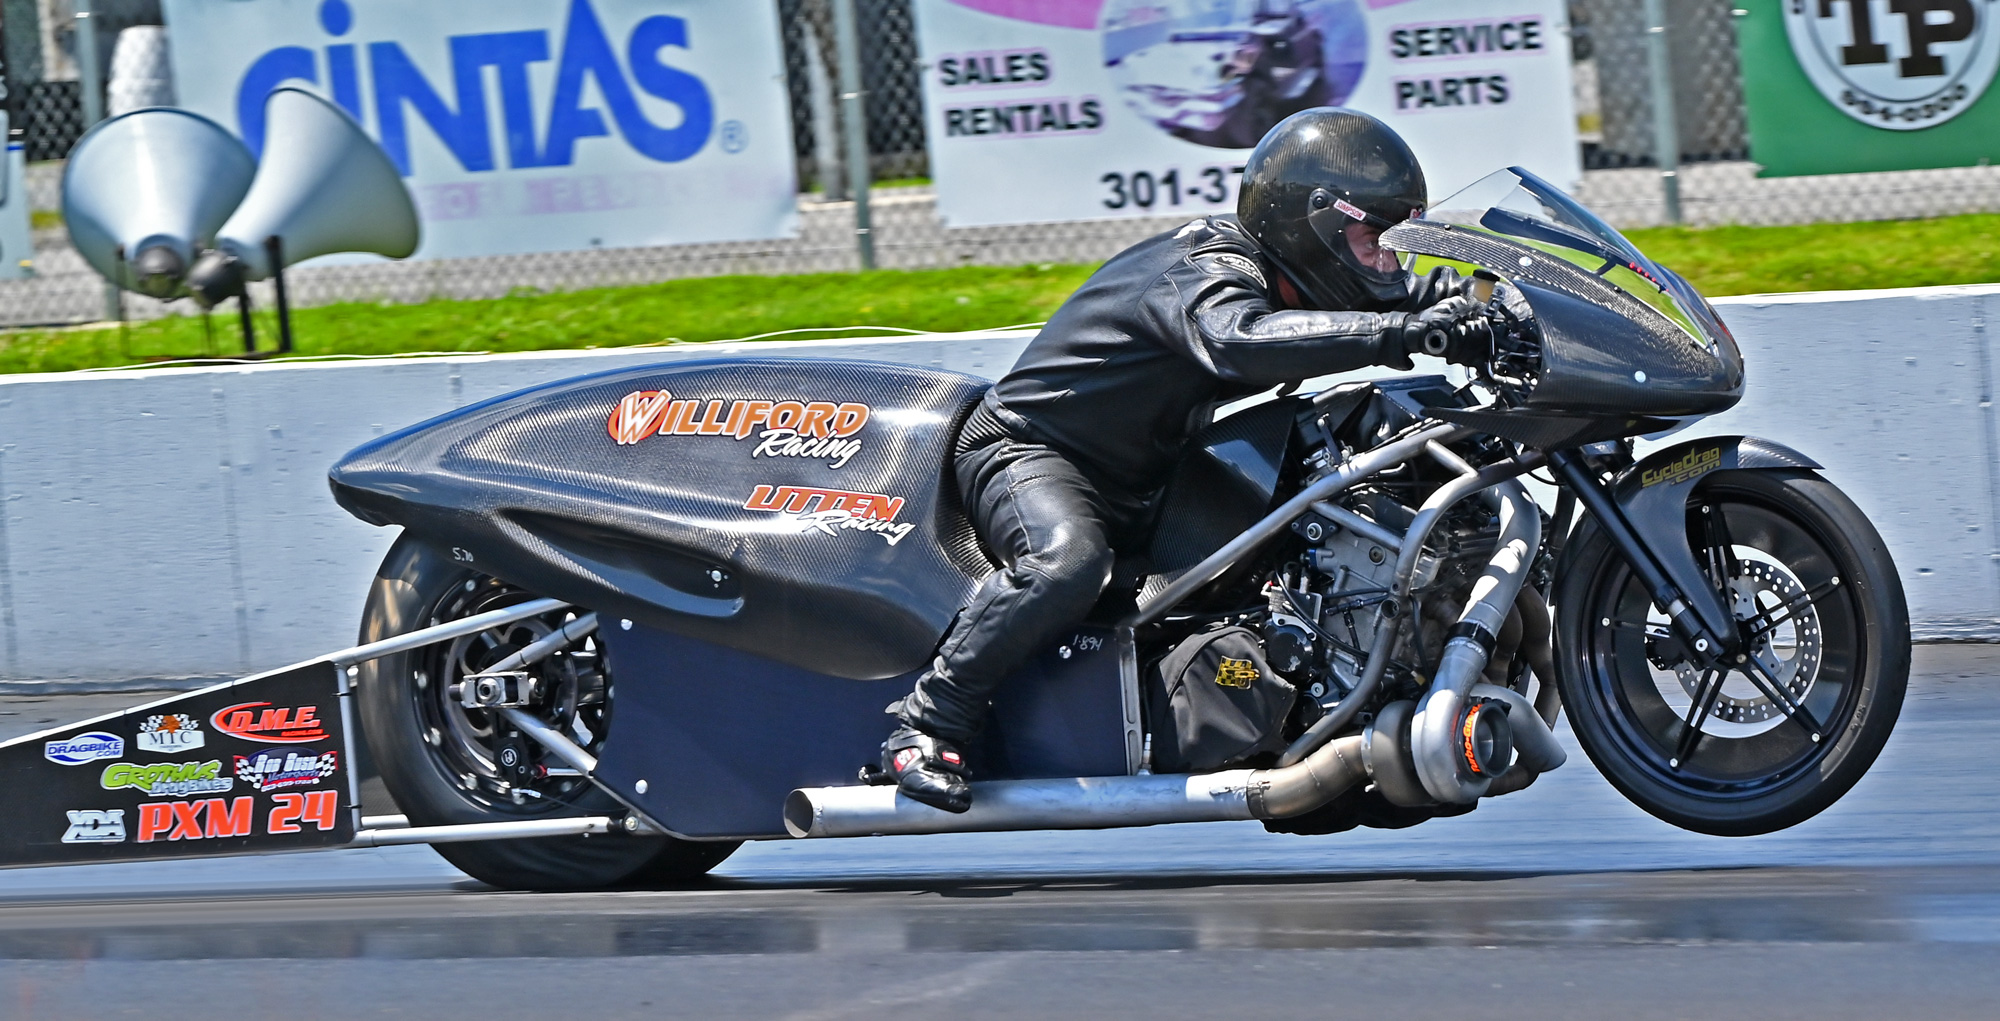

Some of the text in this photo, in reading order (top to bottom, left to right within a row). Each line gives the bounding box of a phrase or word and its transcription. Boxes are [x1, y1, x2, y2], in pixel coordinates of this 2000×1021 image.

[1390, 21, 1543, 58] SERVICE
[1817, 0, 1976, 78] TP
[939, 53, 1050, 86] SALES
[1396, 75, 1509, 109] PARTS
[945, 101, 1103, 137] RENTALS
[1335, 201, 1364, 219] SIMPSON
[607, 389, 870, 445] WILLIFORD
[752, 429, 862, 469] Racing
[743, 485, 905, 524] UTTEN
[797, 509, 916, 546] Racing
[149, 730, 192, 745] MTC
[226, 706, 321, 733] D.M.E.
[47, 741, 121, 755] DRAGBIKE
[103, 761, 222, 790] GROTHUS
[137, 790, 338, 843] PXM 24
